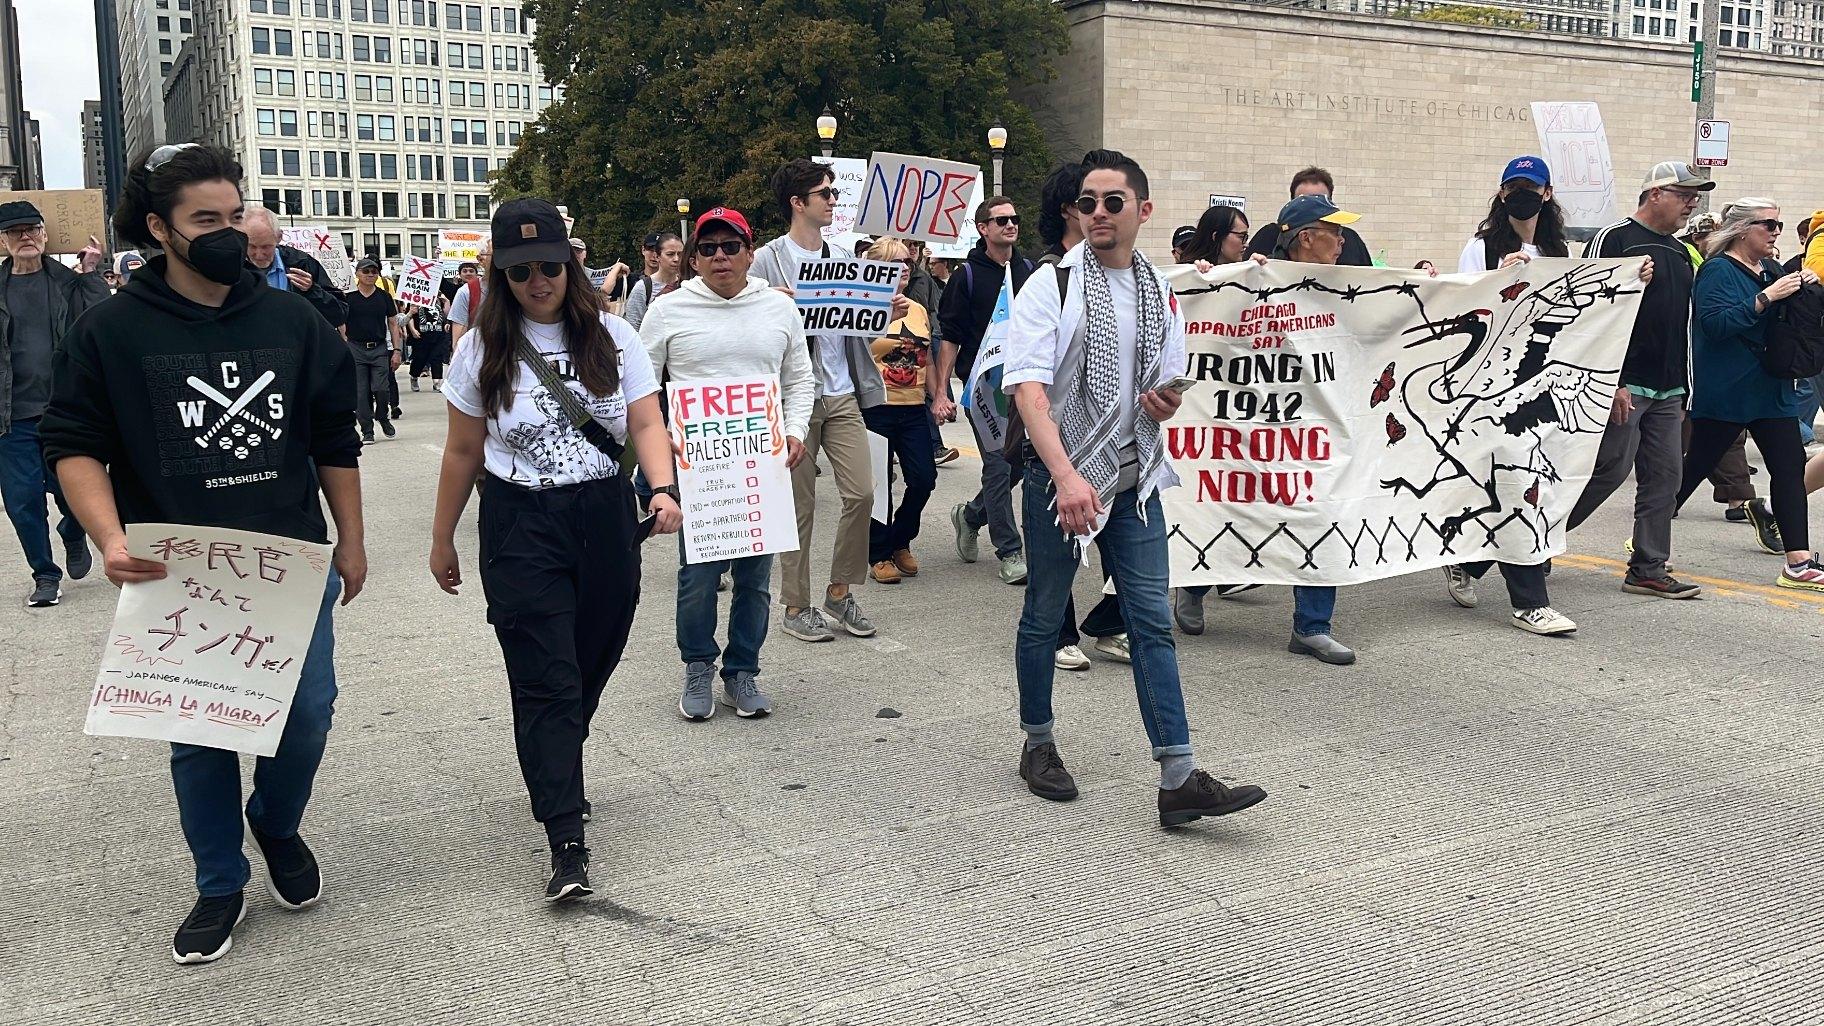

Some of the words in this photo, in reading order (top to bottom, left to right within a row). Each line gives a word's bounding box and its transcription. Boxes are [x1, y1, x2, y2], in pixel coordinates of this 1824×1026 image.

[1224, 89, 1261, 105] THE
[1271, 91, 1306, 108] ART
[1316, 94, 1418, 115] INSTITUTE
[1426, 101, 1448, 116] OF
[1457, 103, 1528, 123] CHICAG
[859, 163, 976, 237] NOPE
[406, 276, 430, 287] NEVER
[799, 262, 859, 281] HANDS
[863, 264, 899, 284] OFF
[400, 292, 436, 307] NOW!
[405, 282, 430, 293] AGAIN
[1184, 321, 1262, 338] APANESE
[1267, 313, 1335, 334] AMERICANS
[1240, 303, 1296, 323] CHICAGO
[1252, 335, 1286, 350] SAY
[1312, 351, 1336, 384] IN
[678, 383, 766, 420] FREE
[974, 386, 1002, 441] PALESTINE
[1213, 389, 1303, 423] 1942
[684, 415, 768, 440] FREE
[686, 432, 771, 463] PALESTINE
[1167, 426, 1330, 462] WRONG
[706, 478, 724, 487] TRUE
[1196, 469, 1314, 507] NOW!
[689, 502, 703, 514] END
[711, 496, 747, 508] OCCUPATION
[691, 519, 705, 530] END
[713, 512, 748, 527] APARTHEID
[693, 533, 717, 545] RETURN
[721, 529, 750, 541] REBUILD
[150, 536, 293, 584] 移民官
[182, 577, 252, 612] なんて
[179, 694, 198, 711] LA
[205, 701, 280, 727] MIGRA!
